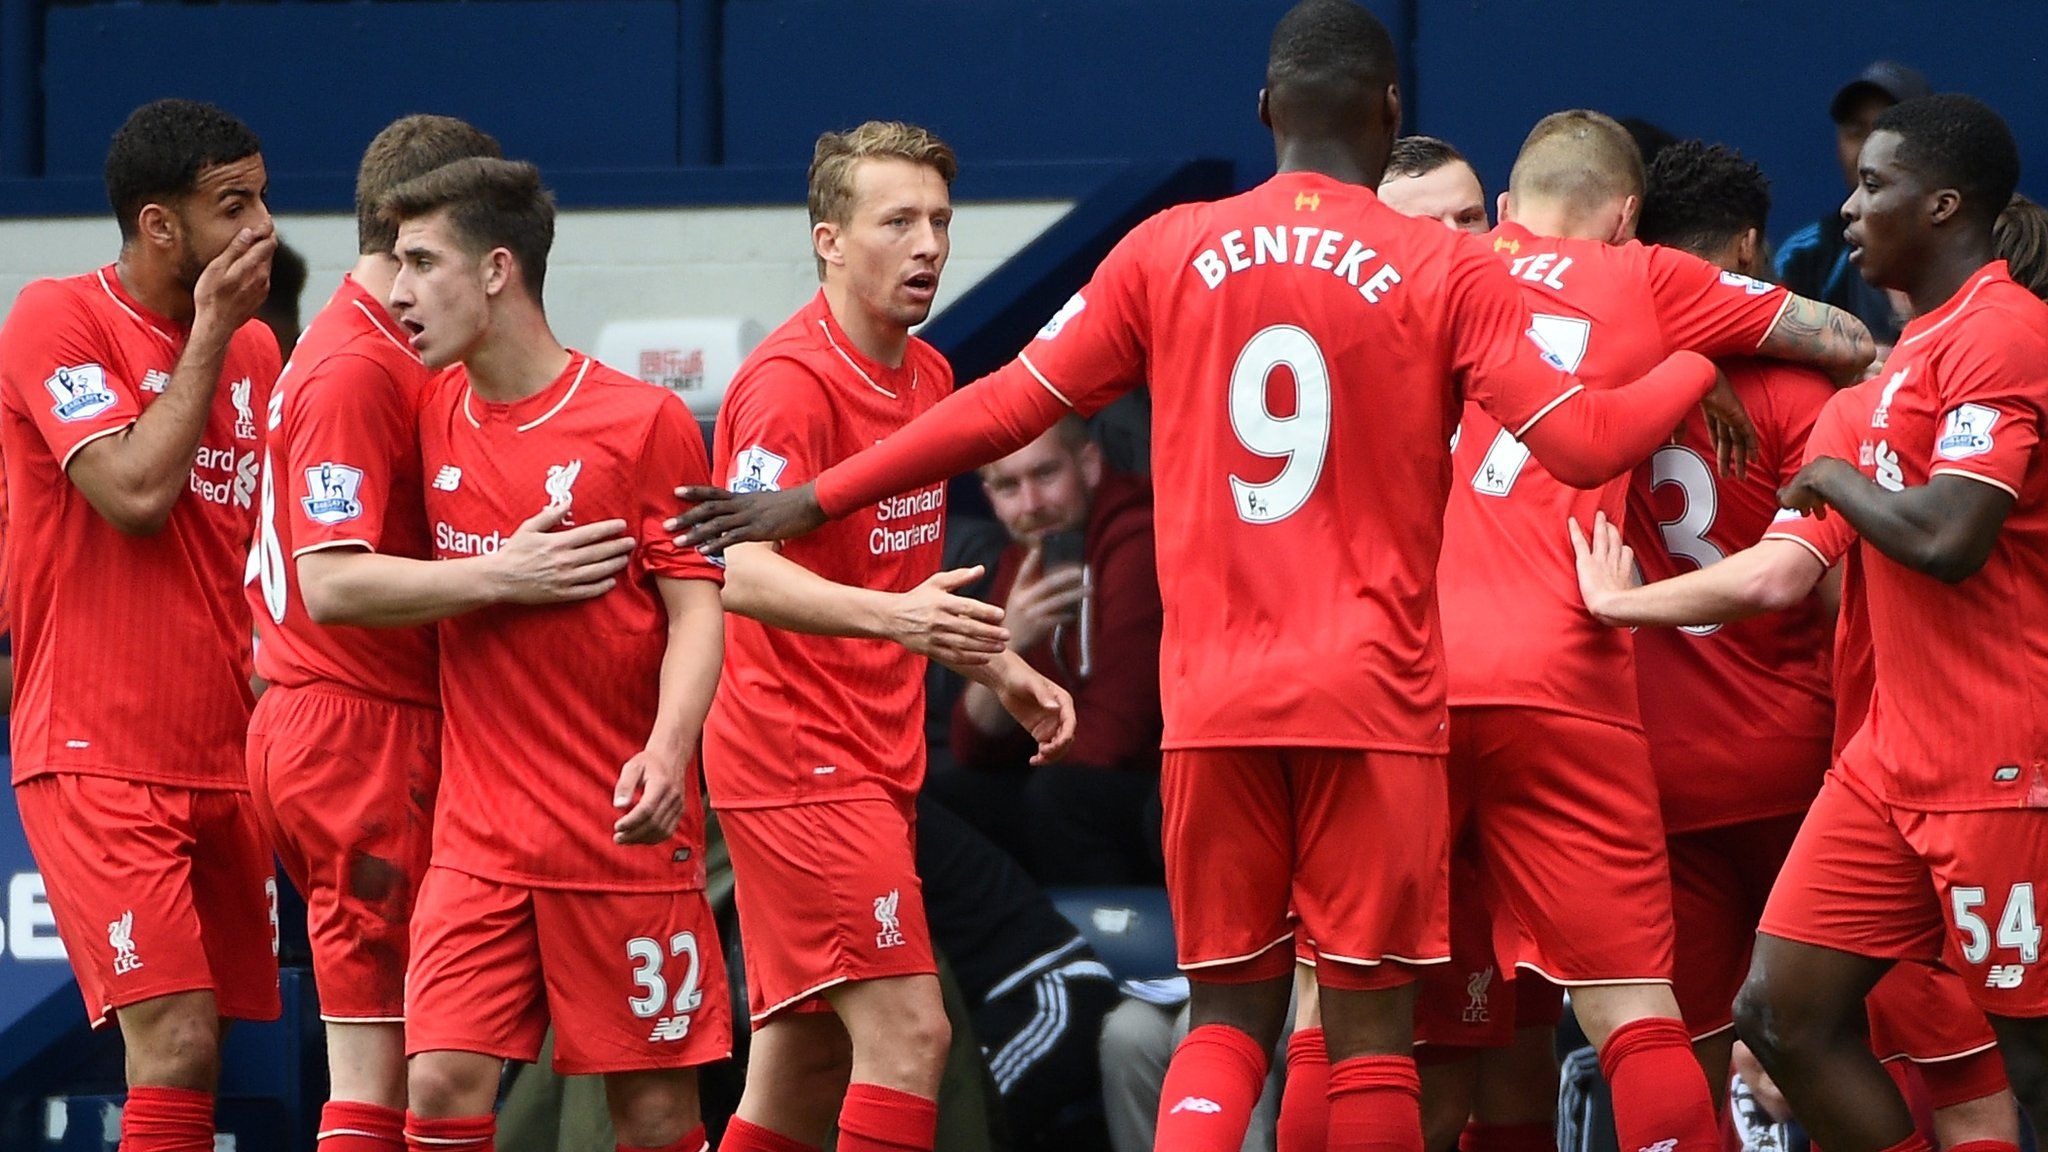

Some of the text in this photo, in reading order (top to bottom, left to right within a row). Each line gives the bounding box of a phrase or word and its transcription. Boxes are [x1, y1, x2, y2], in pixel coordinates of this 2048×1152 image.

[1192, 224, 1403, 305] BENTEKE
[1228, 323, 1332, 524] 9
[1450, 313, 1592, 497] 7
[869, 513, 942, 555] Chartered
[877, 481, 944, 521] Standard
[0, 872, 68, 960] E
[1951, 882, 2042, 964] 54
[626, 930, 703, 1018] 32
